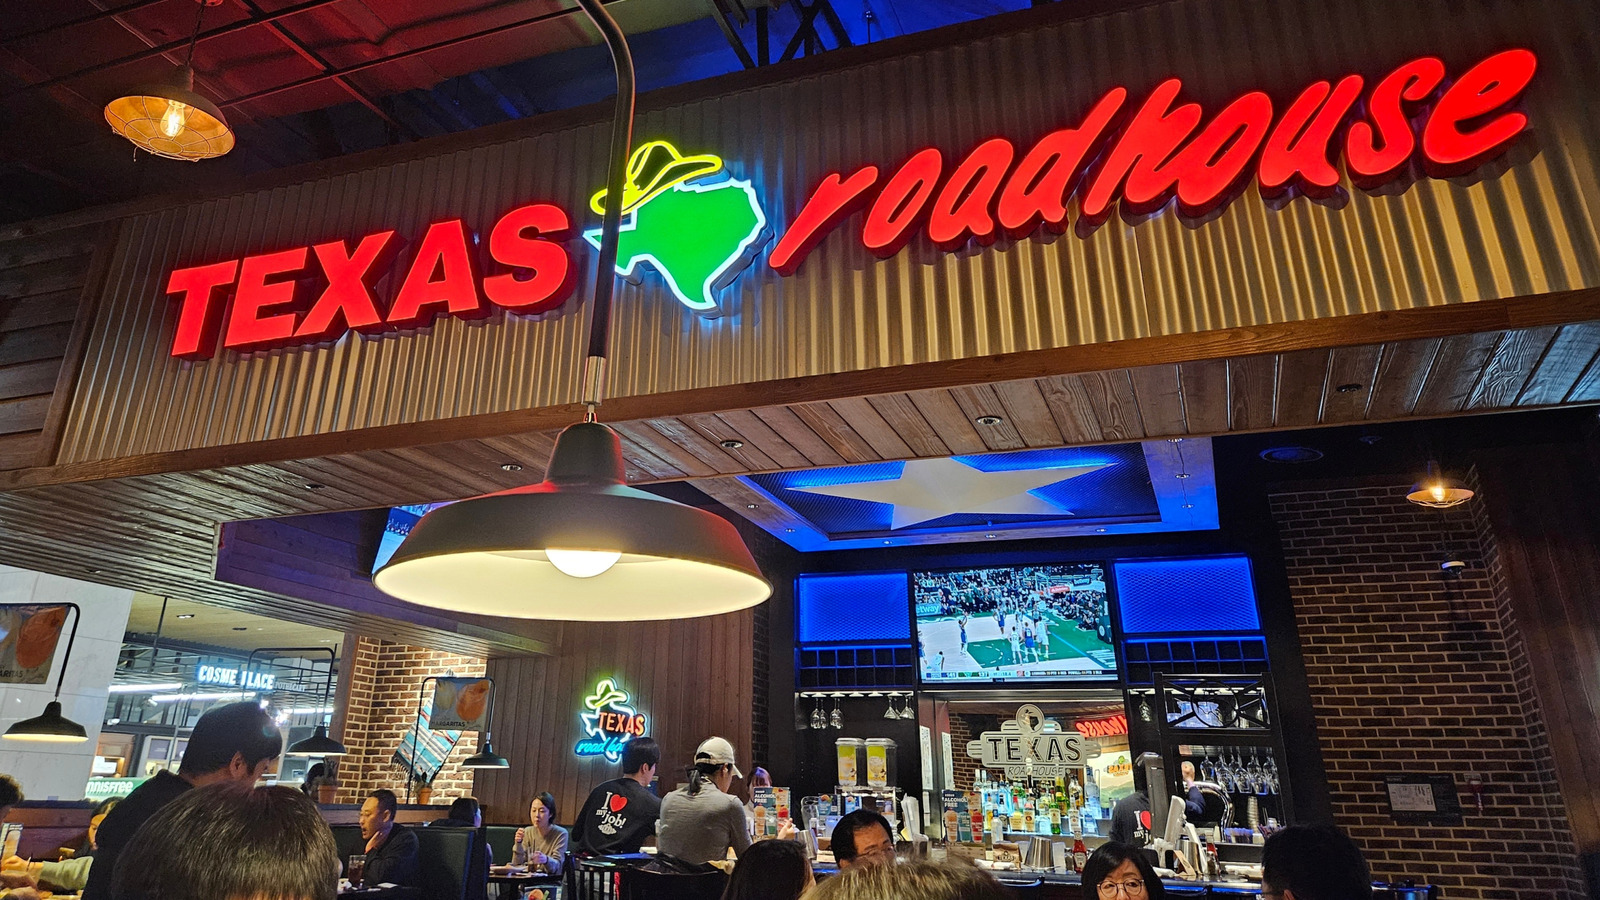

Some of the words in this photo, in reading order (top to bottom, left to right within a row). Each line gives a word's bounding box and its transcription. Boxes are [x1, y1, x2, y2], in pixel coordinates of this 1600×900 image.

[166, 204, 570, 357] TEXAS
[769, 48, 1538, 268] roadhouse
[198, 664, 239, 685] COSME
[598, 711, 645, 736] TEXAS
[985, 736, 1082, 763] TEXAS
[595, 809, 609, 818] my
[601, 811, 627, 829] job!
